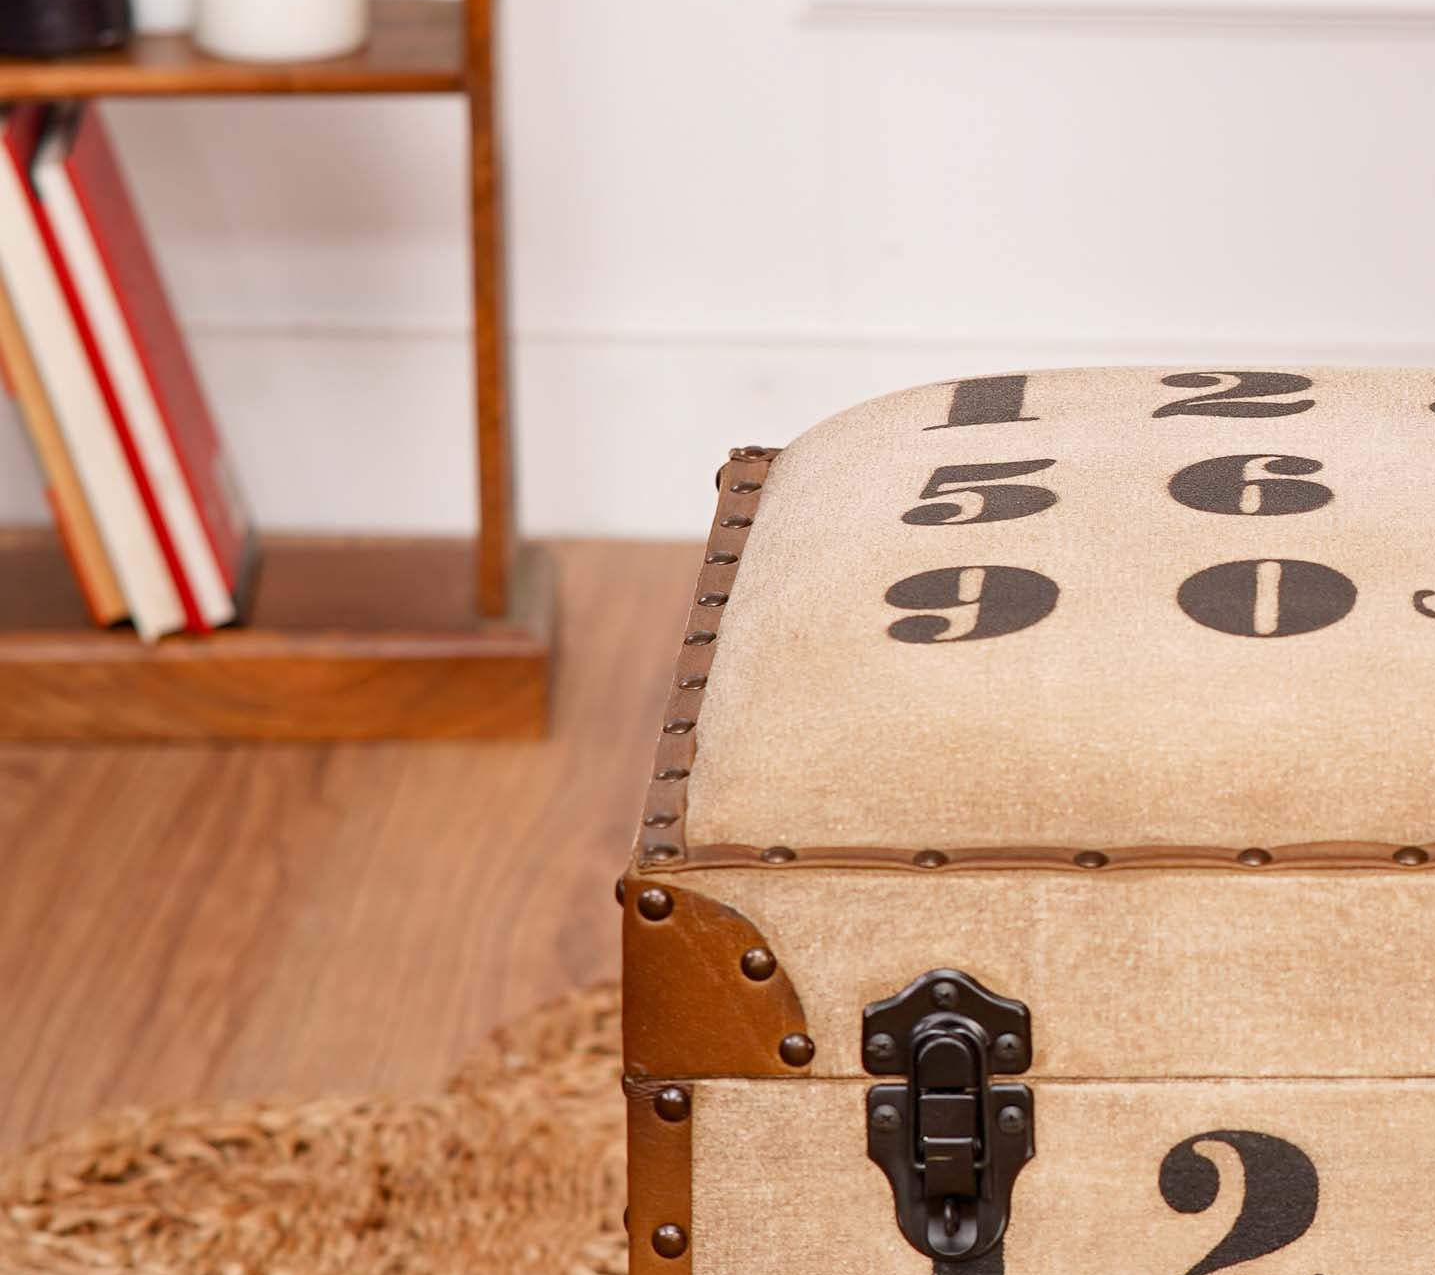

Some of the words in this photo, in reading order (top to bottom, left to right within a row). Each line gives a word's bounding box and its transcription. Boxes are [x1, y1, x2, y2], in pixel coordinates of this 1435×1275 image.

[922, 374, 1041, 431] 1
[1151, 371, 1315, 419] 2
[900, 458, 1058, 526] 5
[1168, 454, 1334, 516] 6
[885, 565, 1060, 644] 9
[1177, 558, 1358, 638] 0
